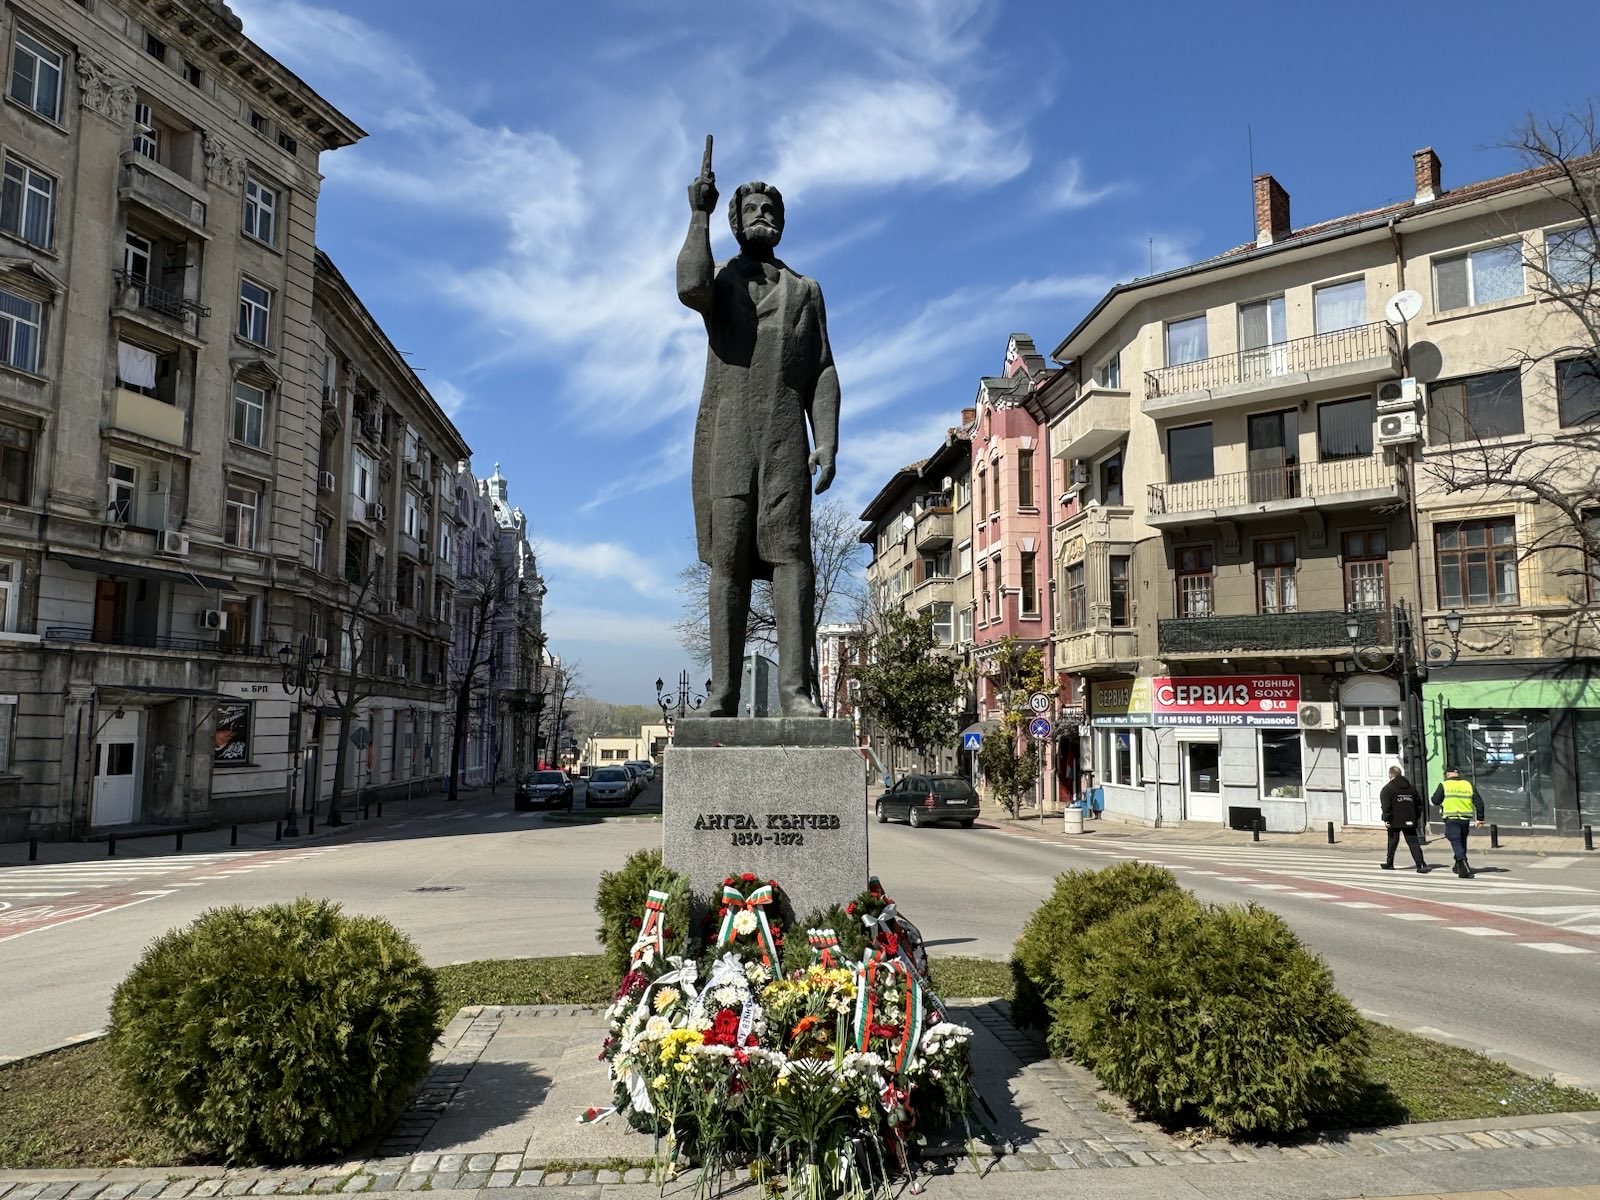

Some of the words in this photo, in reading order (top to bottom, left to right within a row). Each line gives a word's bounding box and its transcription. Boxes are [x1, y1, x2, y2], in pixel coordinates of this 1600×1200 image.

[251, 685, 268, 693] БРП
[1251, 680, 1295, 688] TOSHIBA
[1097, 687, 1129, 707] СЕРВИЗ
[1157, 684, 1250, 706] СЕРВИЗ
[1254, 689, 1294, 698] SONY
[1033, 697, 1047, 709] 30
[1273, 700, 1287, 709] LG
[1157, 715, 1202, 724] SAMSUNG
[1205, 715, 1243, 724] PHILIPS
[1246, 715, 1296, 725] Panasonic
[694, 813, 759, 830] АНГЕЛ
[766, 813, 841, 830] КЪНЧЕВ
